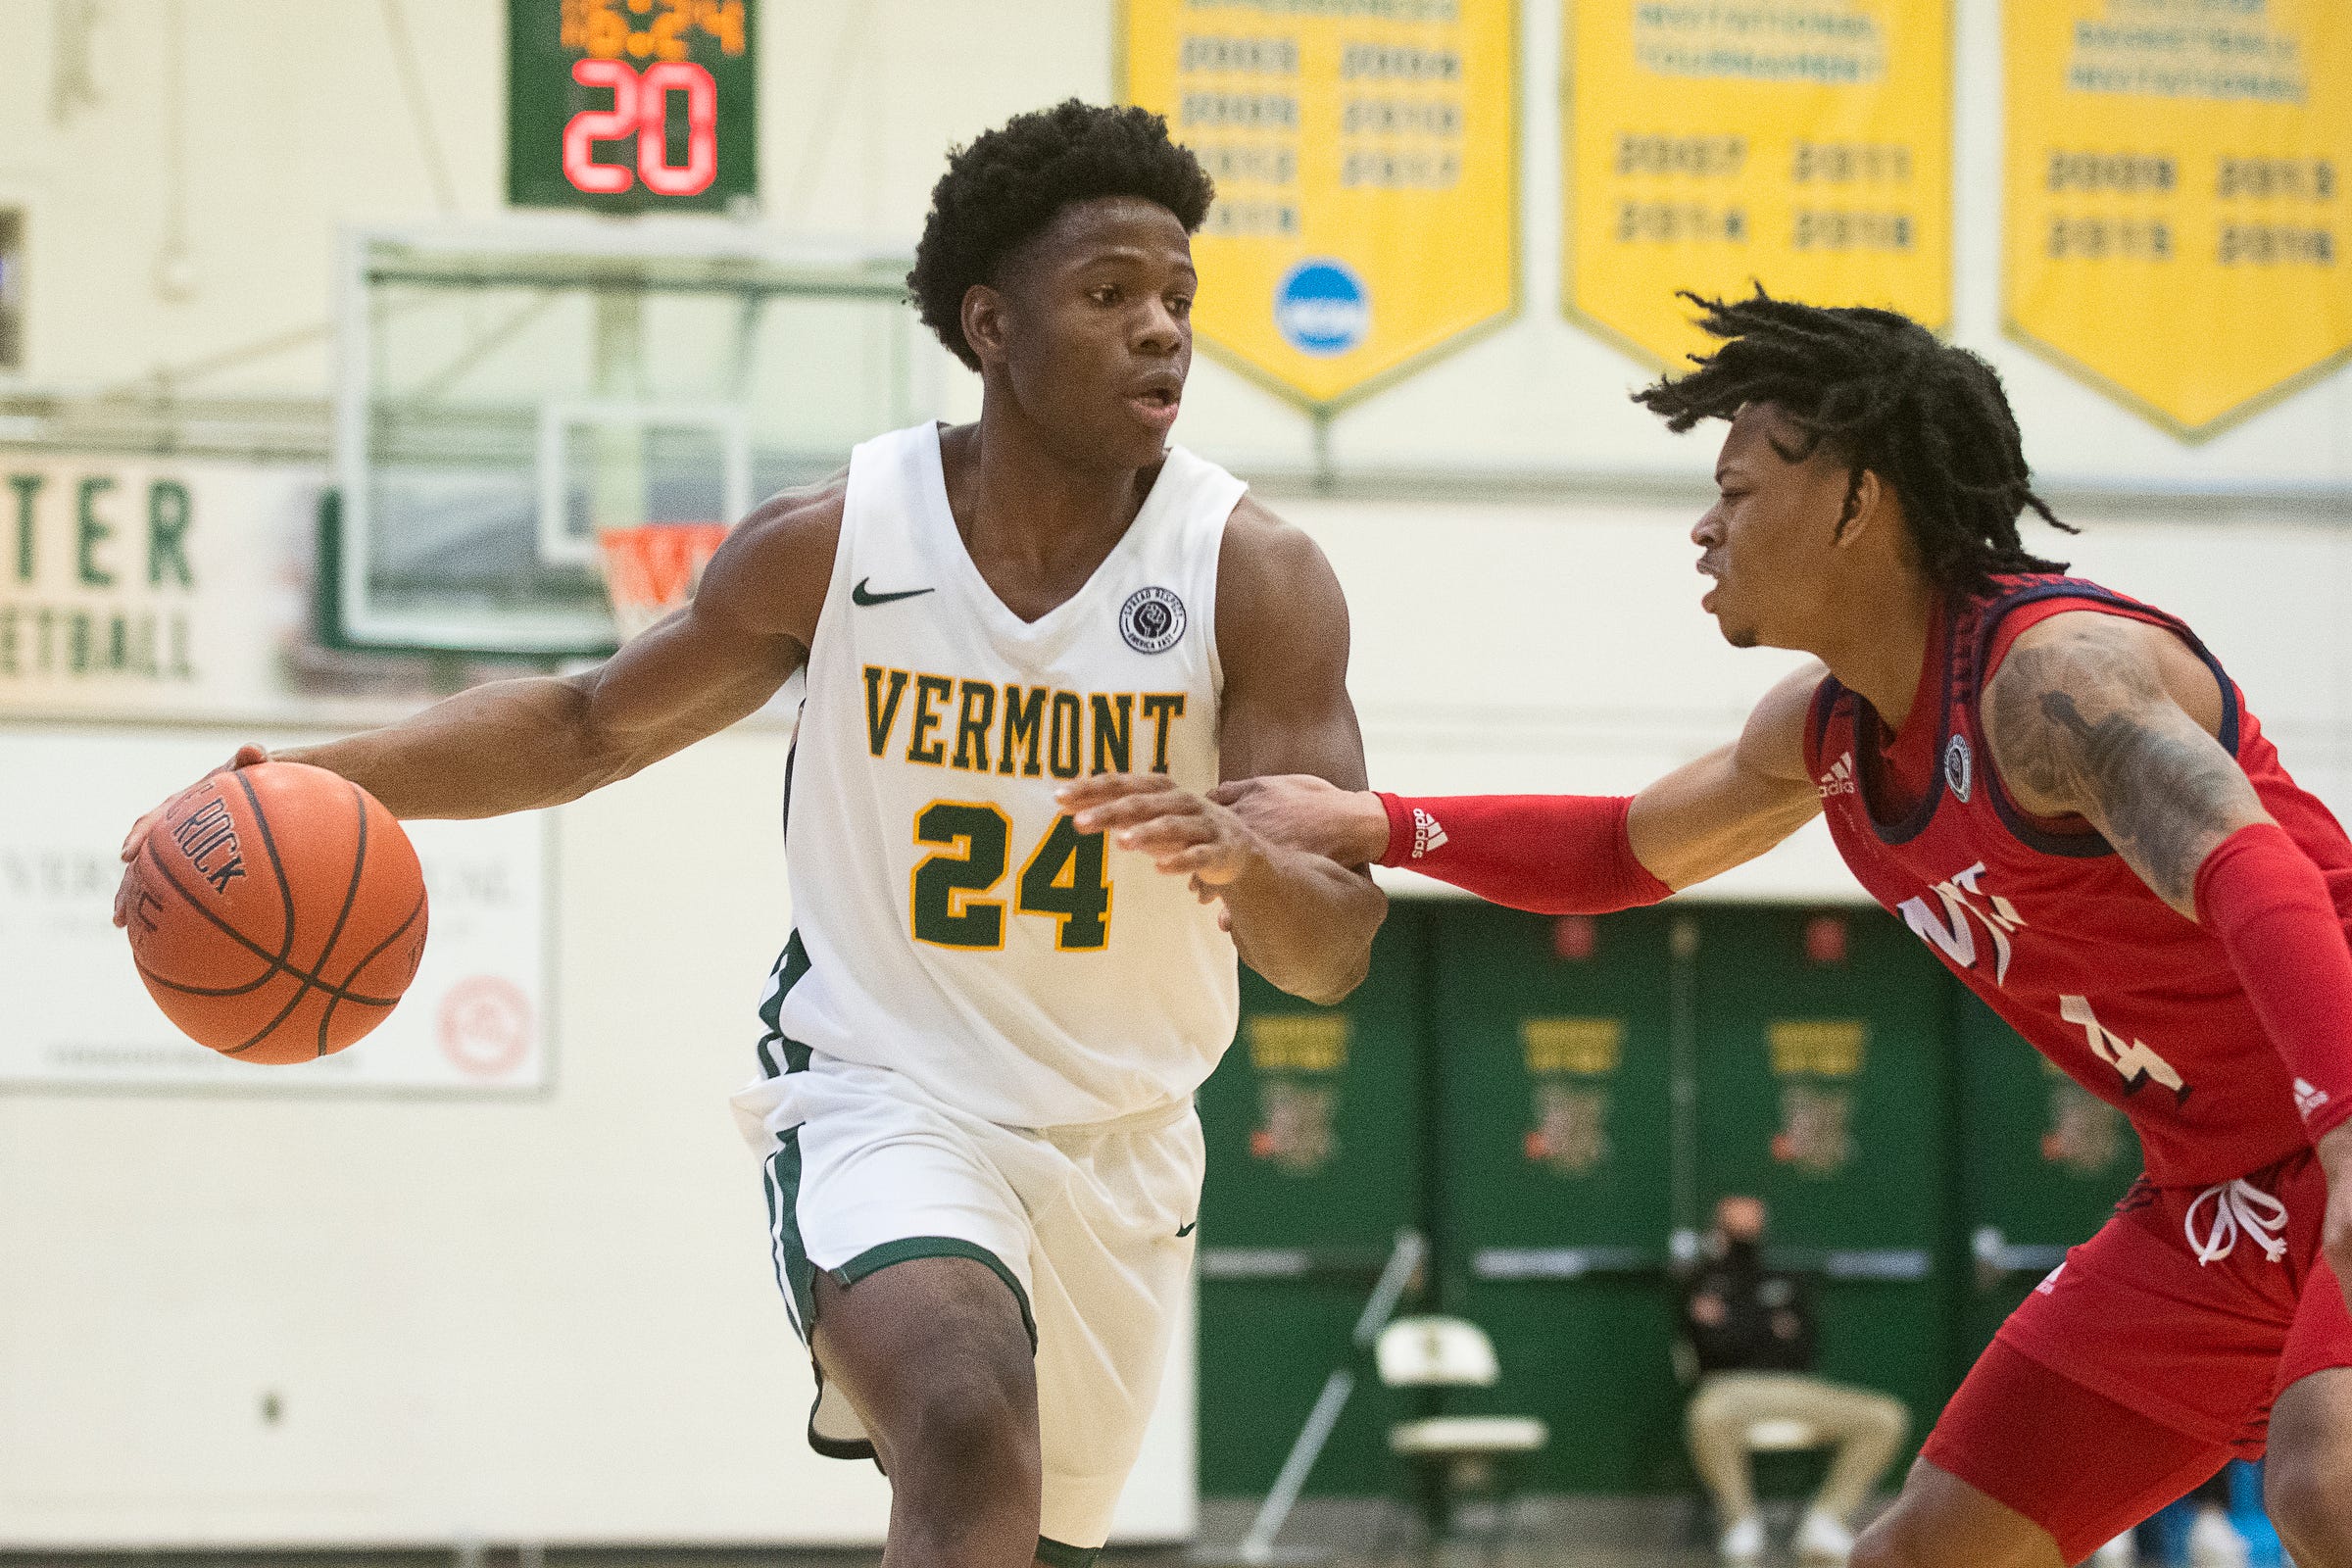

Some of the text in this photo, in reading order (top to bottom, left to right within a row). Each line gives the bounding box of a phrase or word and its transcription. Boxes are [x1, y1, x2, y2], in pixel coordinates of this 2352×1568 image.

[563, 58, 717, 196] 20
[6, 474, 197, 590] TER
[862, 664, 1187, 780] VERMONT
[173, 798, 246, 894] ROCK
[909, 798, 1114, 952] 24
[1412, 808, 1428, 858] adidas
[2059, 994, 2189, 1100] 4
